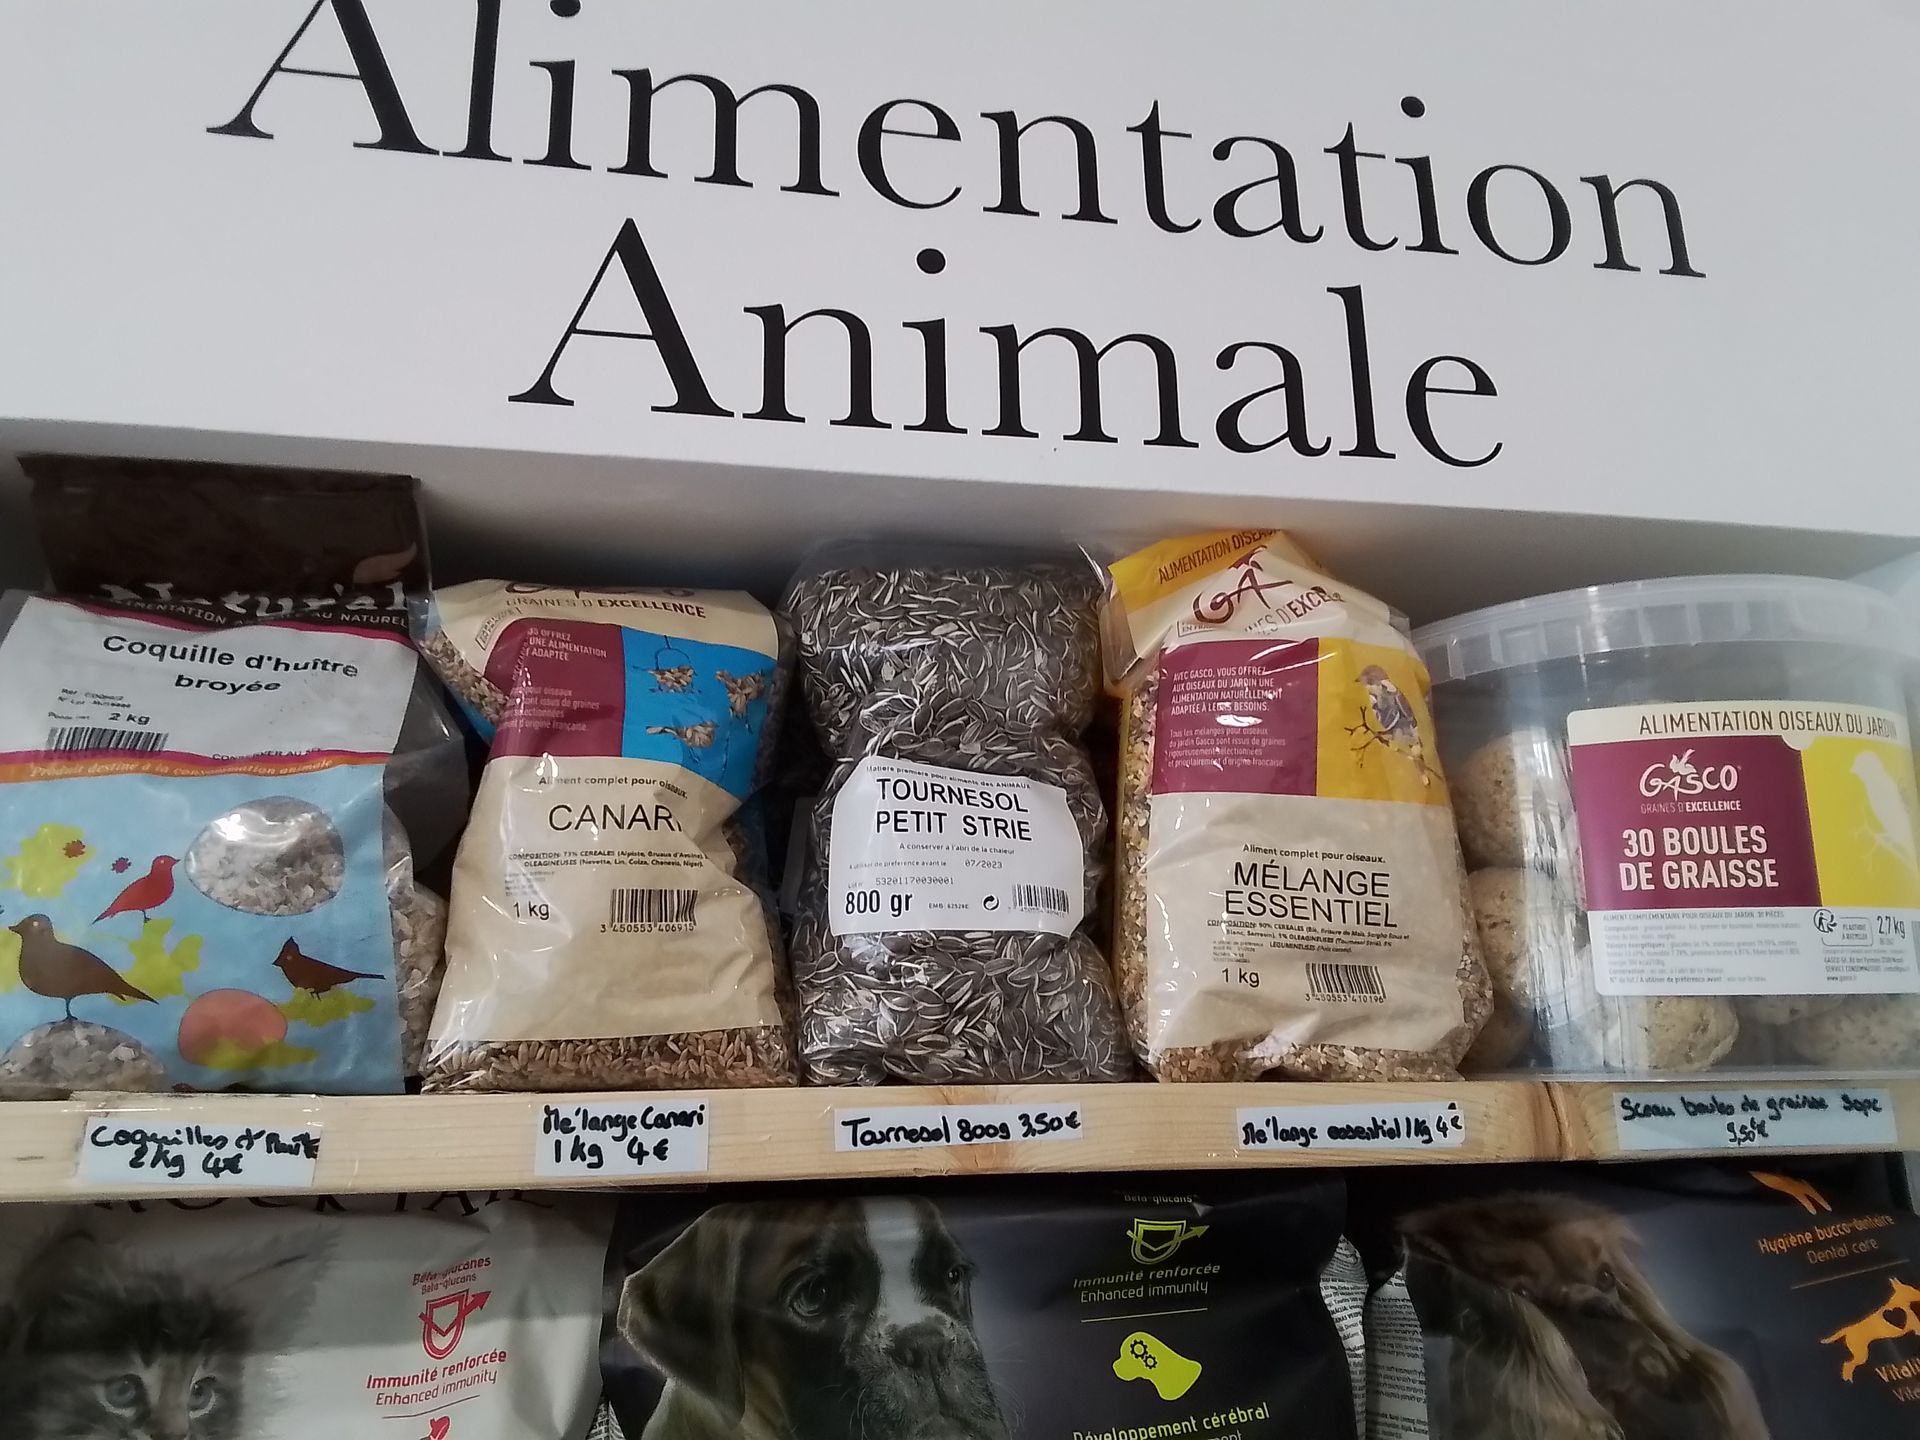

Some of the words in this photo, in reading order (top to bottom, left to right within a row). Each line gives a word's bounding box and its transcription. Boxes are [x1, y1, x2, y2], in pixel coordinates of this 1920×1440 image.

[206, 0, 1706, 277] Alimentation
[508, 217, 1504, 467] Animale
[1158, 538, 1231, 585] ALIMENTATION
[1232, 529, 1280, 550] OISEAU
[341, 613, 408, 629] NATUREL
[103, 635, 234, 666] Coquille
[245, 654, 359, 678] d'huître
[529, 637, 547, 648] UNE
[548, 640, 607, 658] ALIMENTATION
[174, 674, 282, 695] broyée
[1172, 682, 1185, 693] AUX
[1186, 680, 1216, 691] OISEAUX
[1217, 679, 1228, 688] DU
[1229, 678, 1257, 688] JARDIN
[1258, 678, 1275, 688] UNE
[1173, 671, 1189, 682] AVEC
[1189, 669, 1215, 679] GASCO,
[1217, 666, 1237, 677] VOUS
[1238, 666, 1267, 676] OFFREZ
[1171, 691, 1220, 704] ALIMENTATION
[1220, 688, 1283, 700] NATURELLEMENT
[109, 713, 121, 721] 2
[126, 714, 151, 725] kg
[1171, 703, 1200, 716] ADAPTÉE
[1233, 701, 1270, 712] BESOINS.
[1639, 710, 1774, 735] ALIMENTATION
[1778, 711, 1843, 733] OISEAUX
[1846, 713, 1863, 735] DU
[1195, 737, 1215, 746] Gasco
[1251, 737, 1260, 745] de
[584, 776, 628, 787] complet
[631, 777, 657, 787] pour
[931, 770, 947, 779] pour
[996, 782, 1031, 790] ANIMAUX
[1639, 762, 1739, 800] GASCO
[876, 778, 1029, 813] TOURNESOL
[1640, 802, 1676, 815] GRAINES
[876, 810, 948, 834] PETIT
[962, 815, 1033, 841] STRIE
[981, 846, 988, 854] la
[989, 847, 1015, 855] chaleur
[1242, 843, 1277, 856] Aliment
[1279, 847, 1319, 861] complet
[1321, 851, 1344, 862] pour
[1346, 852, 1386, 864] oiseaux.
[1622, 827, 1655, 858] 30
[1662, 825, 1768, 856] BOULES
[965, 859, 1003, 869] 07/2023
[1619, 861, 1654, 891] DE
[1662, 858, 1780, 890] GRAISSE
[1233, 858, 1391, 898] MÉLANGE
[513, 902, 520, 918] 1
[529, 902, 550, 921] kg
[845, 889, 881, 915] 800
[890, 893, 913, 918] gr
[1225, 889, 1398, 928] ESSENTIEL
[612, 923, 653, 933] 450553
[658, 923, 695, 932] 406915
[1893, 916, 1906, 940] kg
[1221, 967, 1230, 983] 1
[1238, 967, 1260, 988] kg
[1350, 994, 1385, 1004] 410196
[640, 1103, 705, 1130] Canari
[90, 1125, 228, 1151] Coquilles
[841, 1115, 951, 1148] Tournesol
[957, 1118, 1011, 1143] 800g
[129, 1148, 145, 1169] 2
[555, 1139, 562, 1163] 1
[1757, 1230, 1813, 1255] Hygiène
[1806, 1243, 1850, 1265] Dental
[1851, 1236, 1880, 1255] care
[1073, 1269, 1144, 1289] Immunité
[1149, 1263, 1221, 1280] renforcée
[1080, 1285, 1144, 1303] Enhanced
[1149, 1280, 1209, 1297] immunity
[366, 1366, 438, 1390] Immunité
[442, 1349, 508, 1379] renforcée
[375, 1384, 439, 1407] Enhanced
[442, 1369, 498, 1395] immunity
[1202, 1401, 1271, 1430] cérébral
